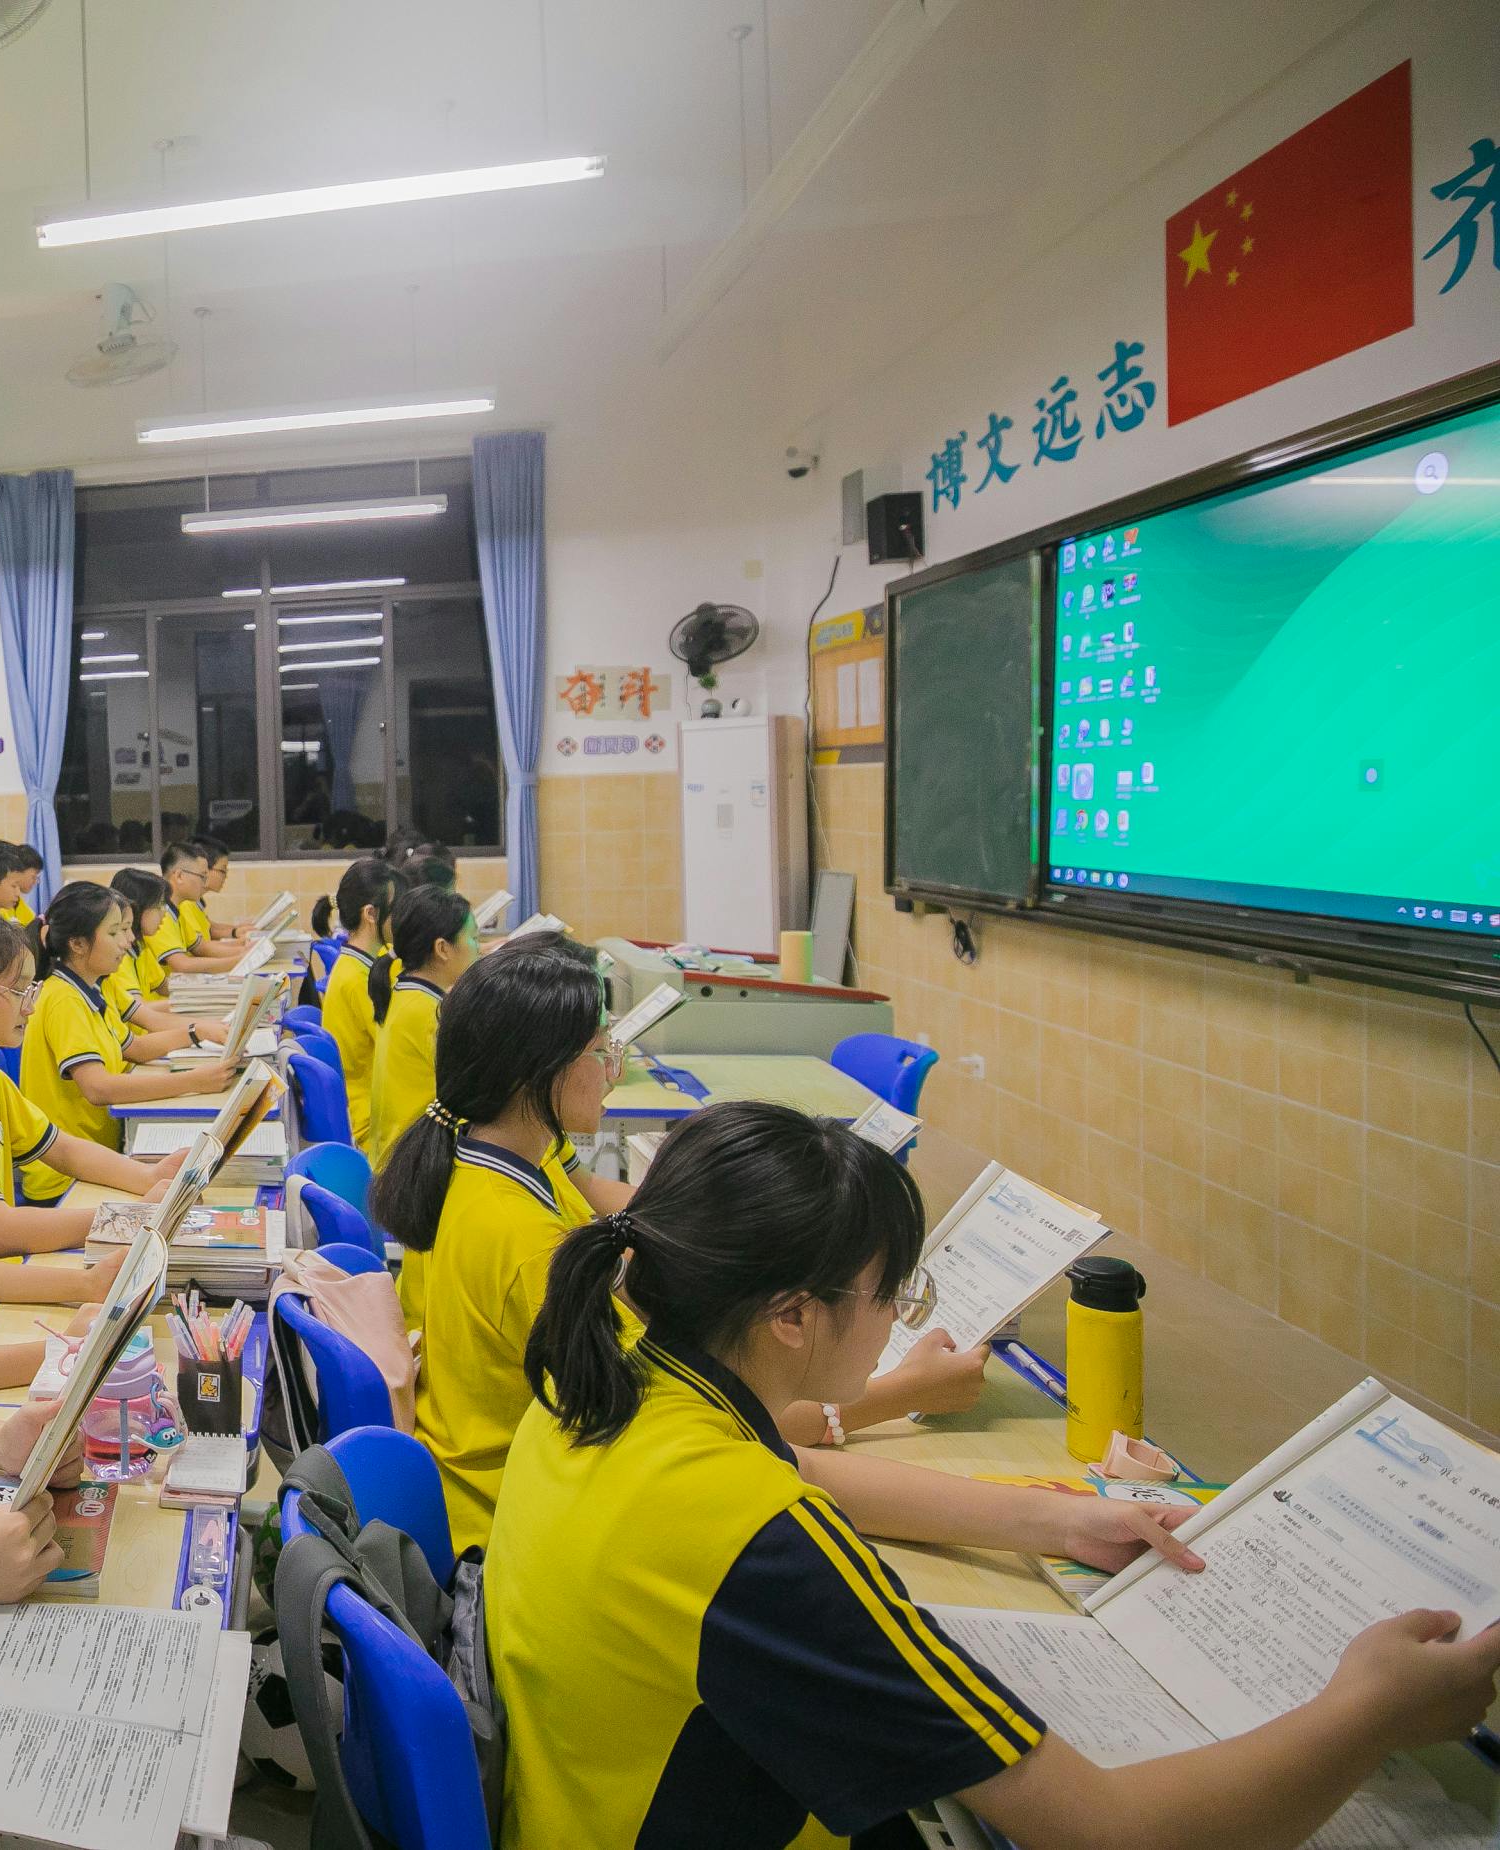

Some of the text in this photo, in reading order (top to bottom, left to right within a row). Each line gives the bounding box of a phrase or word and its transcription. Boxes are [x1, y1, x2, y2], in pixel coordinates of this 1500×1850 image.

[925, 340, 1157, 513] 博文远志
[559, 666, 660, 718] 奋斗
